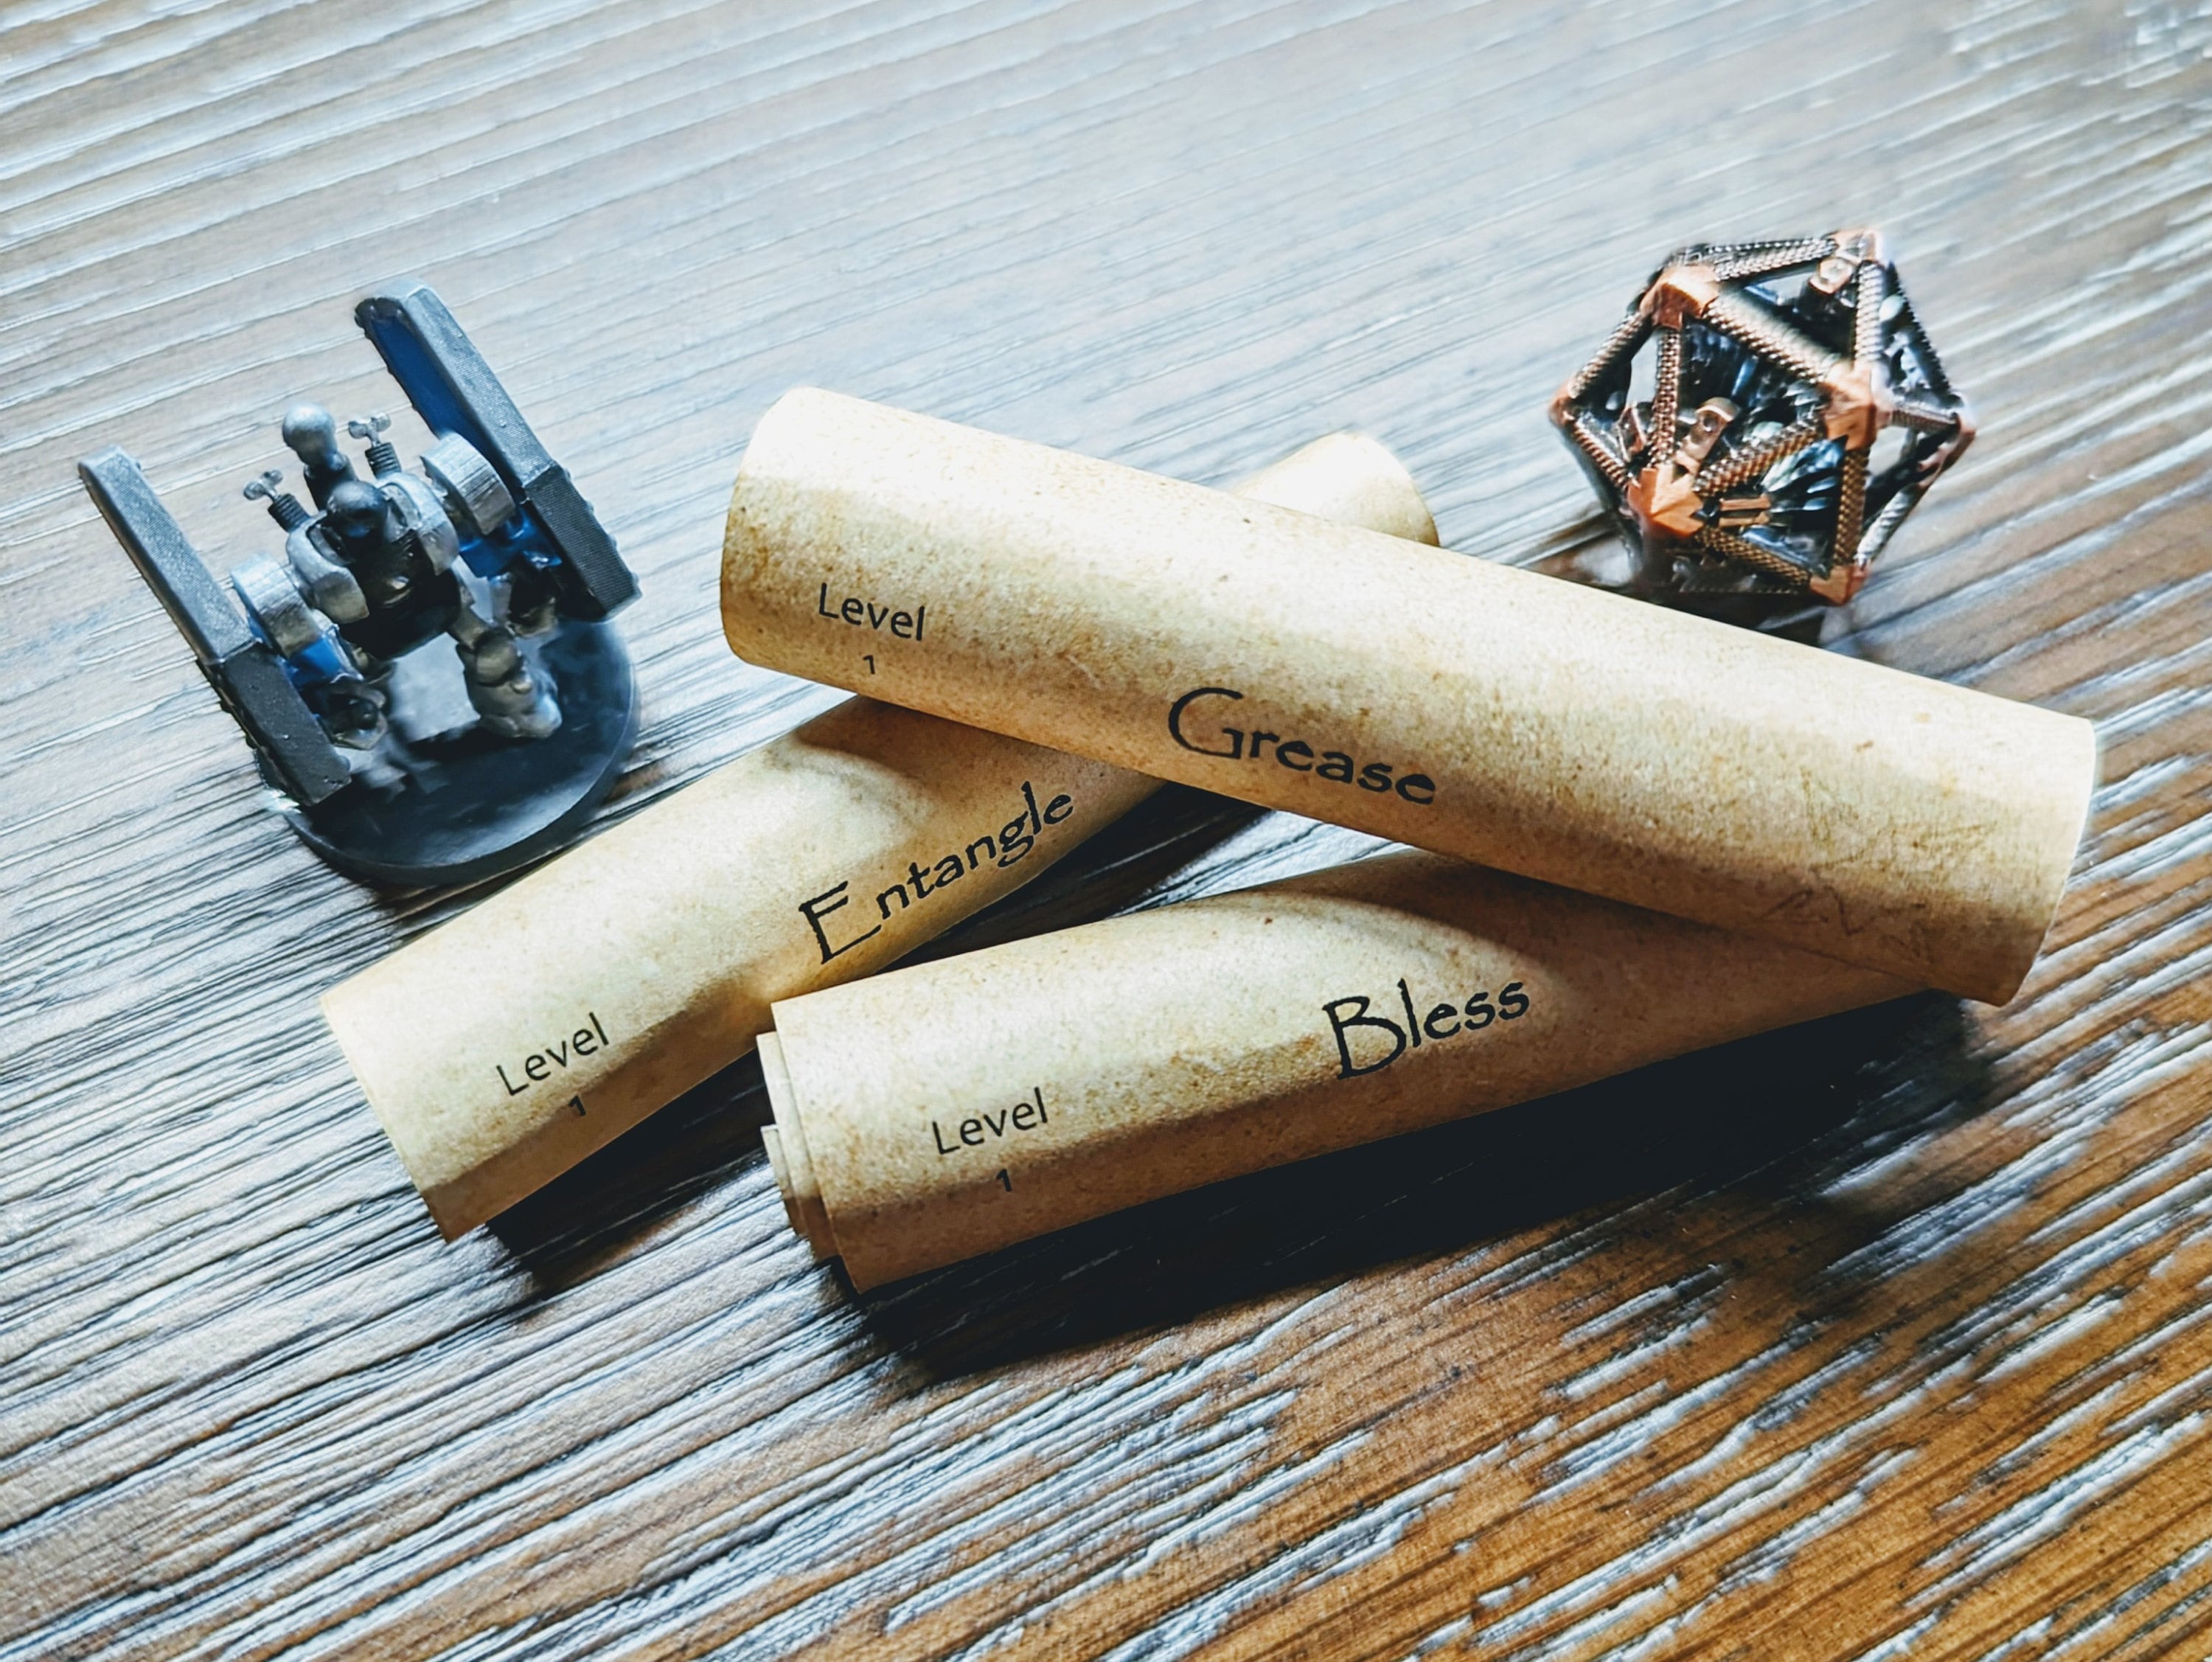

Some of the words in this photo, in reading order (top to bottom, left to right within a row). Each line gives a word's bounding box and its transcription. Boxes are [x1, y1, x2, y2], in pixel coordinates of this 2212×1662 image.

[818, 582, 925, 642] Level
[862, 654, 876, 675] 1
[1167, 686, 1436, 805] Grease
[798, 780, 1074, 965] Entangle
[495, 1011, 610, 1096] Level
[1322, 978, 1531, 1080] Bless
[568, 1094, 586, 1117] 1
[931, 1086, 1049, 1156] Level
[996, 1169, 1012, 1192] 1
